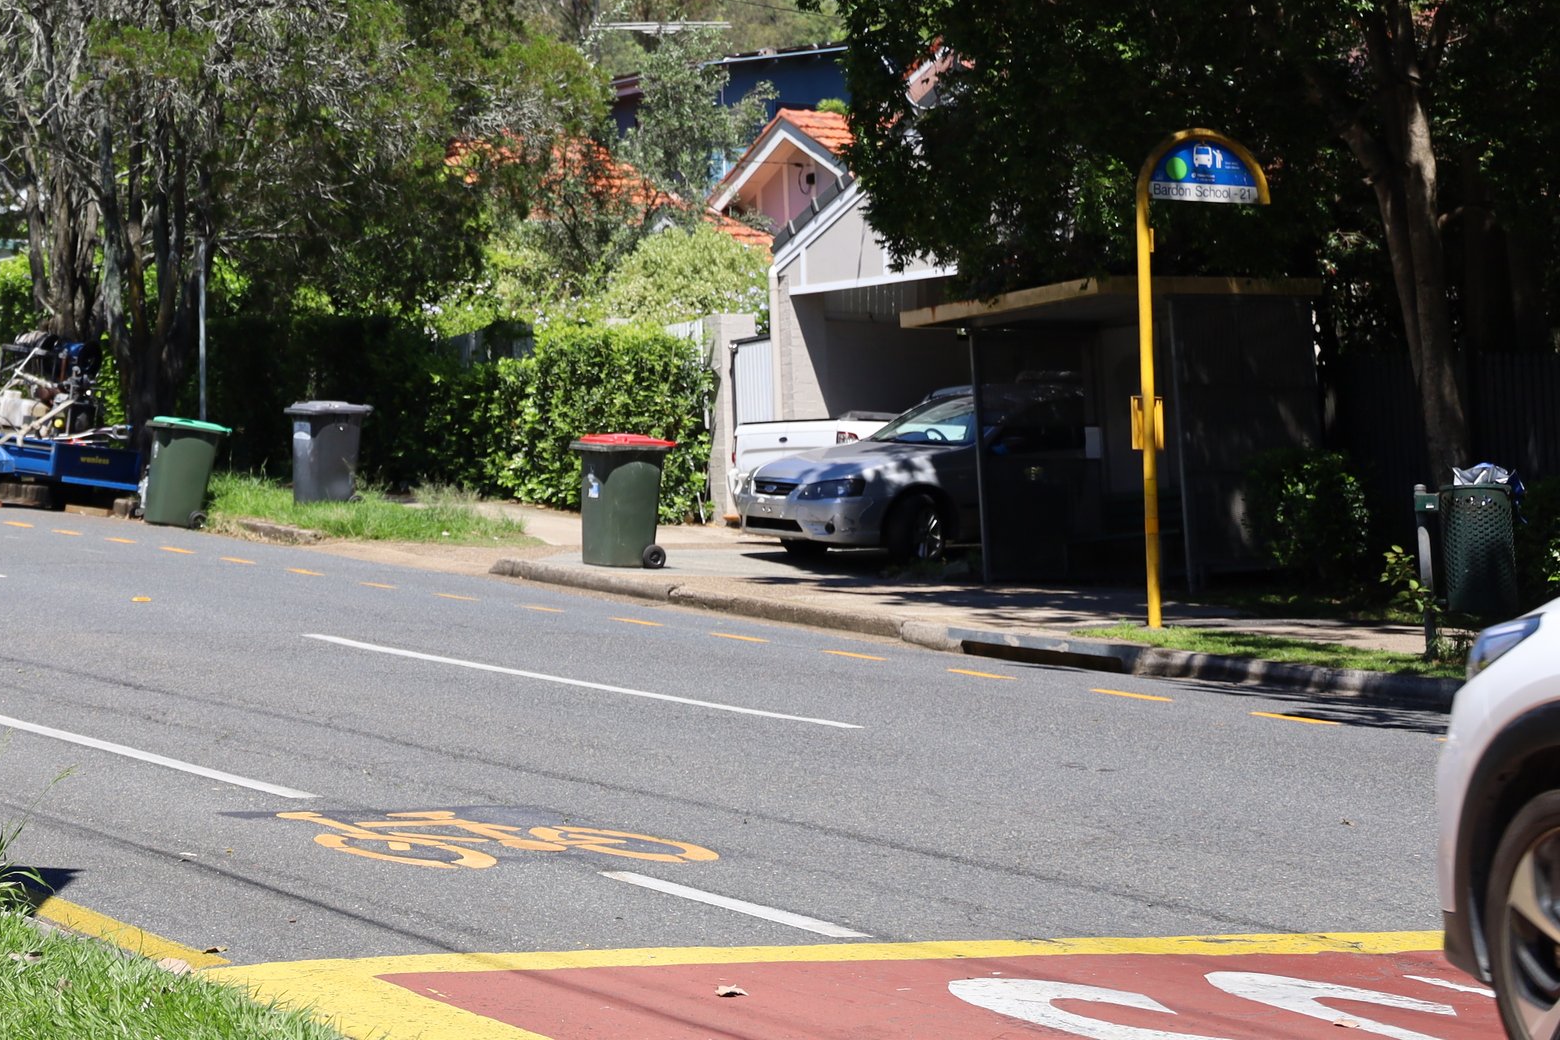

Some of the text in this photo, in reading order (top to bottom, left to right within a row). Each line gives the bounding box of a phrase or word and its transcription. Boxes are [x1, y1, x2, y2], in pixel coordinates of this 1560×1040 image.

[1153, 183, 1191, 196] Bardon
[1195, 186, 1231, 199] School
[1240, 188, 1251, 200] 21
